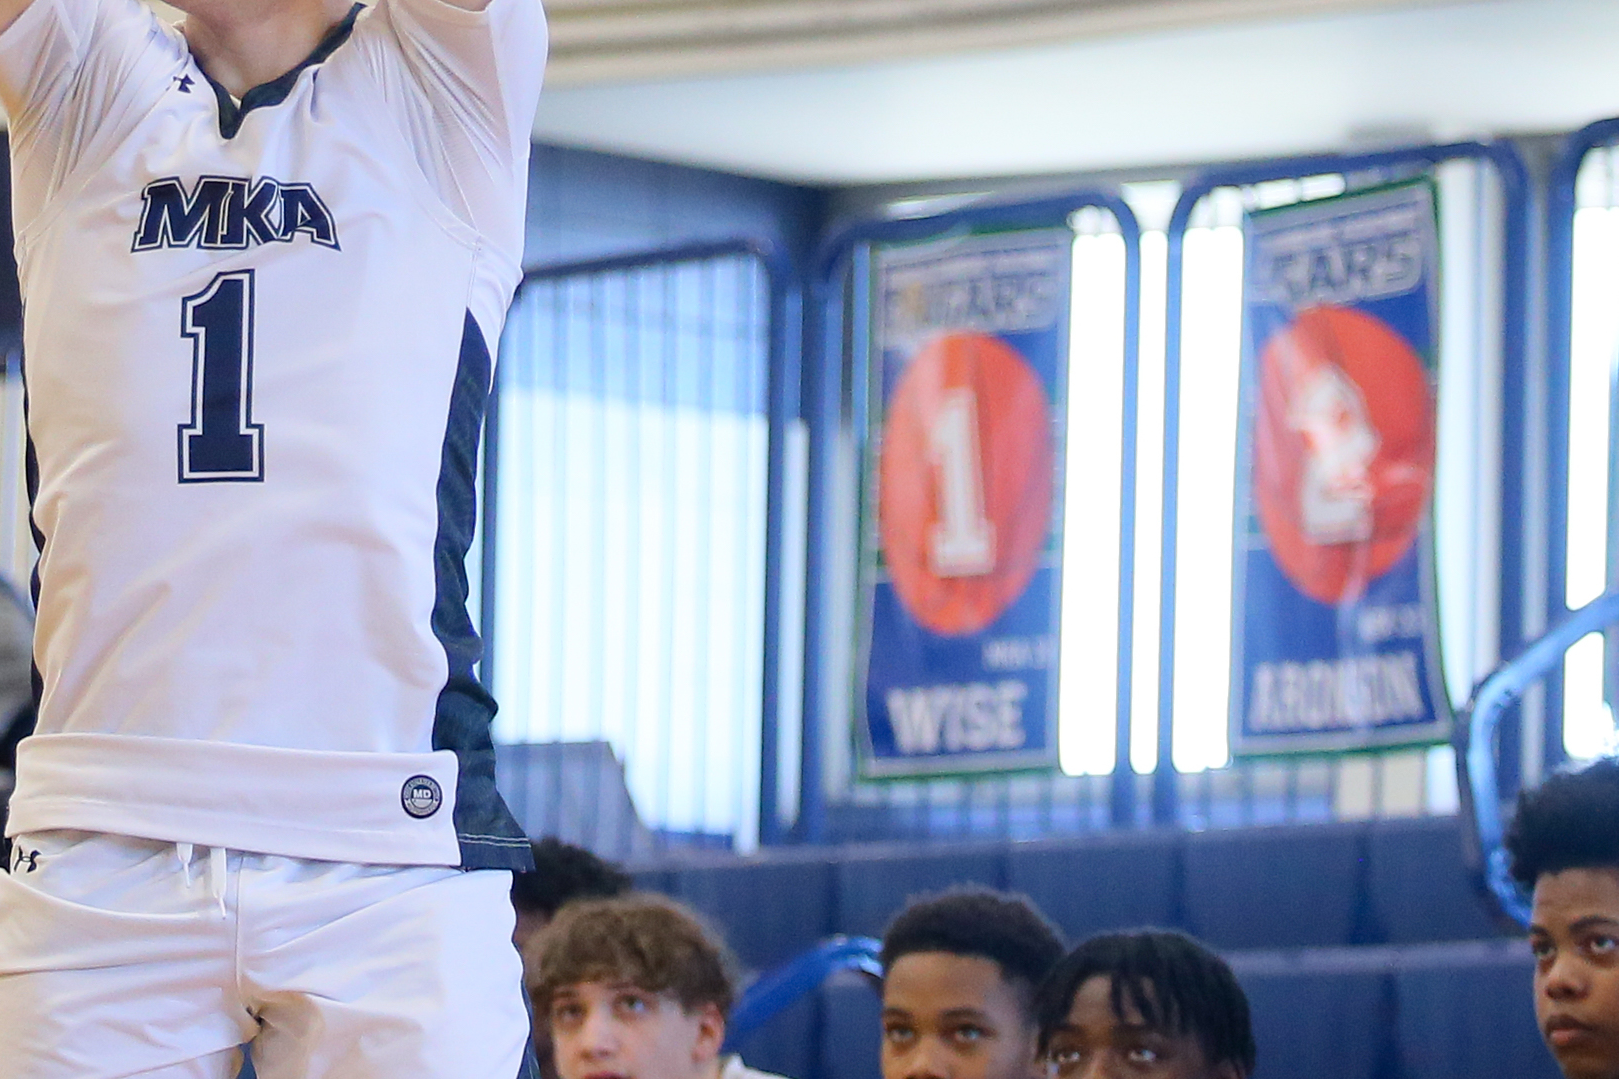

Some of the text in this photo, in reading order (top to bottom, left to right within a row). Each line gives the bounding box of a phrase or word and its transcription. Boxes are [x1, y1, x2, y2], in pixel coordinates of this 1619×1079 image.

[131, 176, 341, 253] MKA
[177, 268, 264, 483] 1
[925, 386, 997, 576] 1
[887, 680, 1028, 755] WISE
[413, 788, 432, 799] MD
